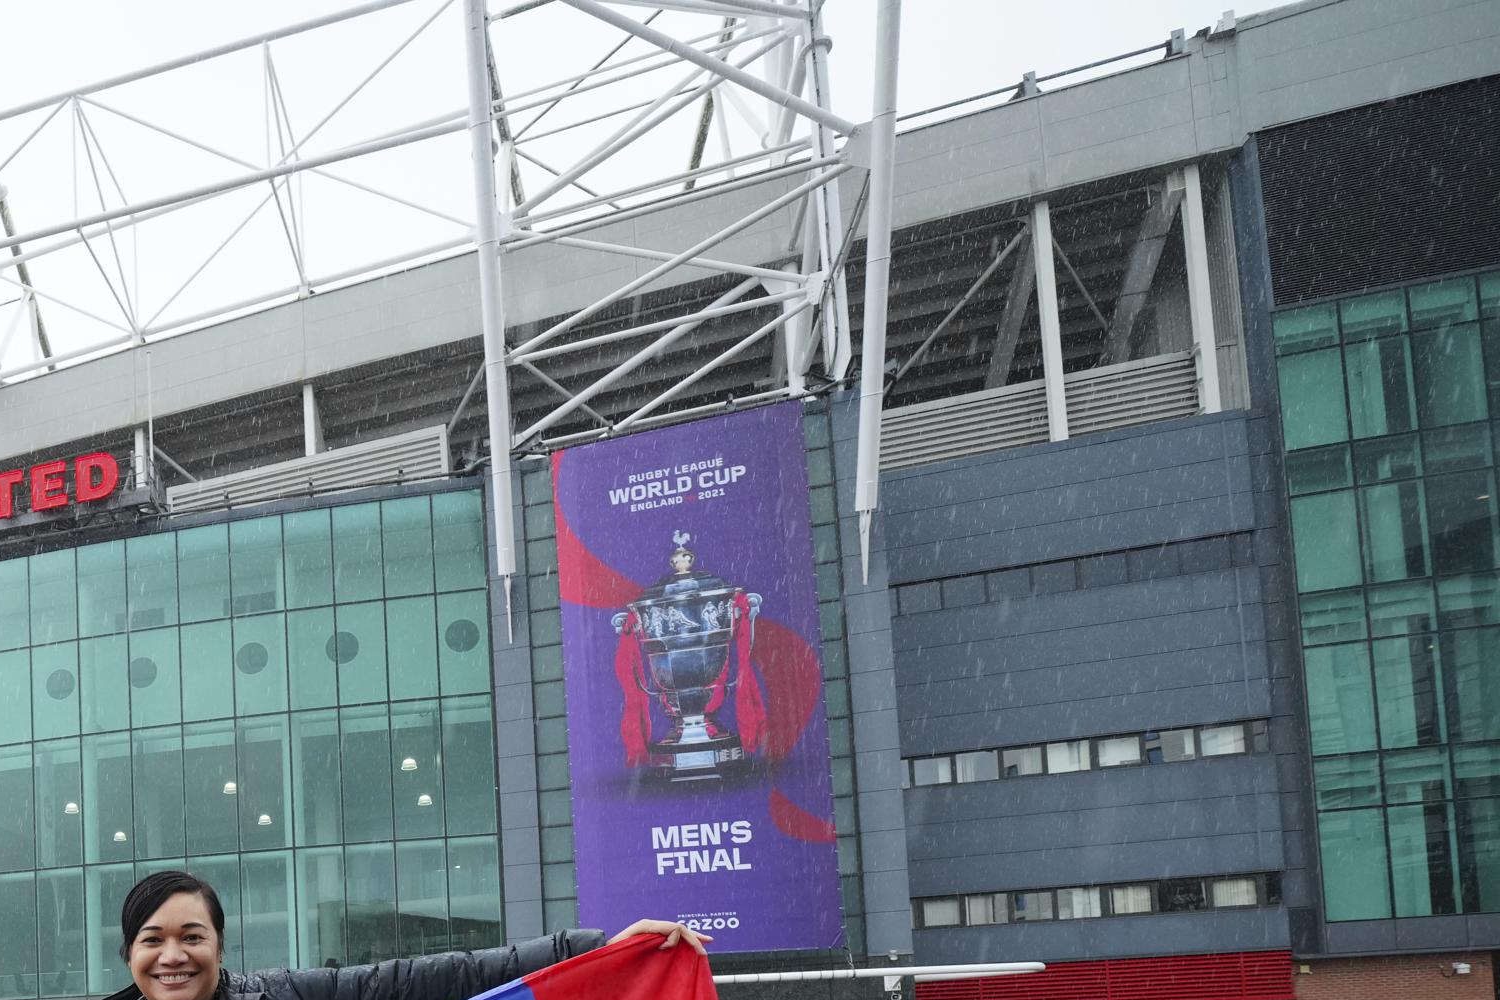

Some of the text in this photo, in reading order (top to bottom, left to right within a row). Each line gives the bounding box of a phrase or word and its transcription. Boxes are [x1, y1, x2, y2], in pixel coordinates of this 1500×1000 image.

[628, 457, 723, 484] RUGBY LEAGUE
[609, 465, 746, 505] WORLD CUP
[630, 488, 725, 512] ENGLAND 2021
[651, 820, 752, 849] MEN'S
[656, 847, 752, 875] FINAL
